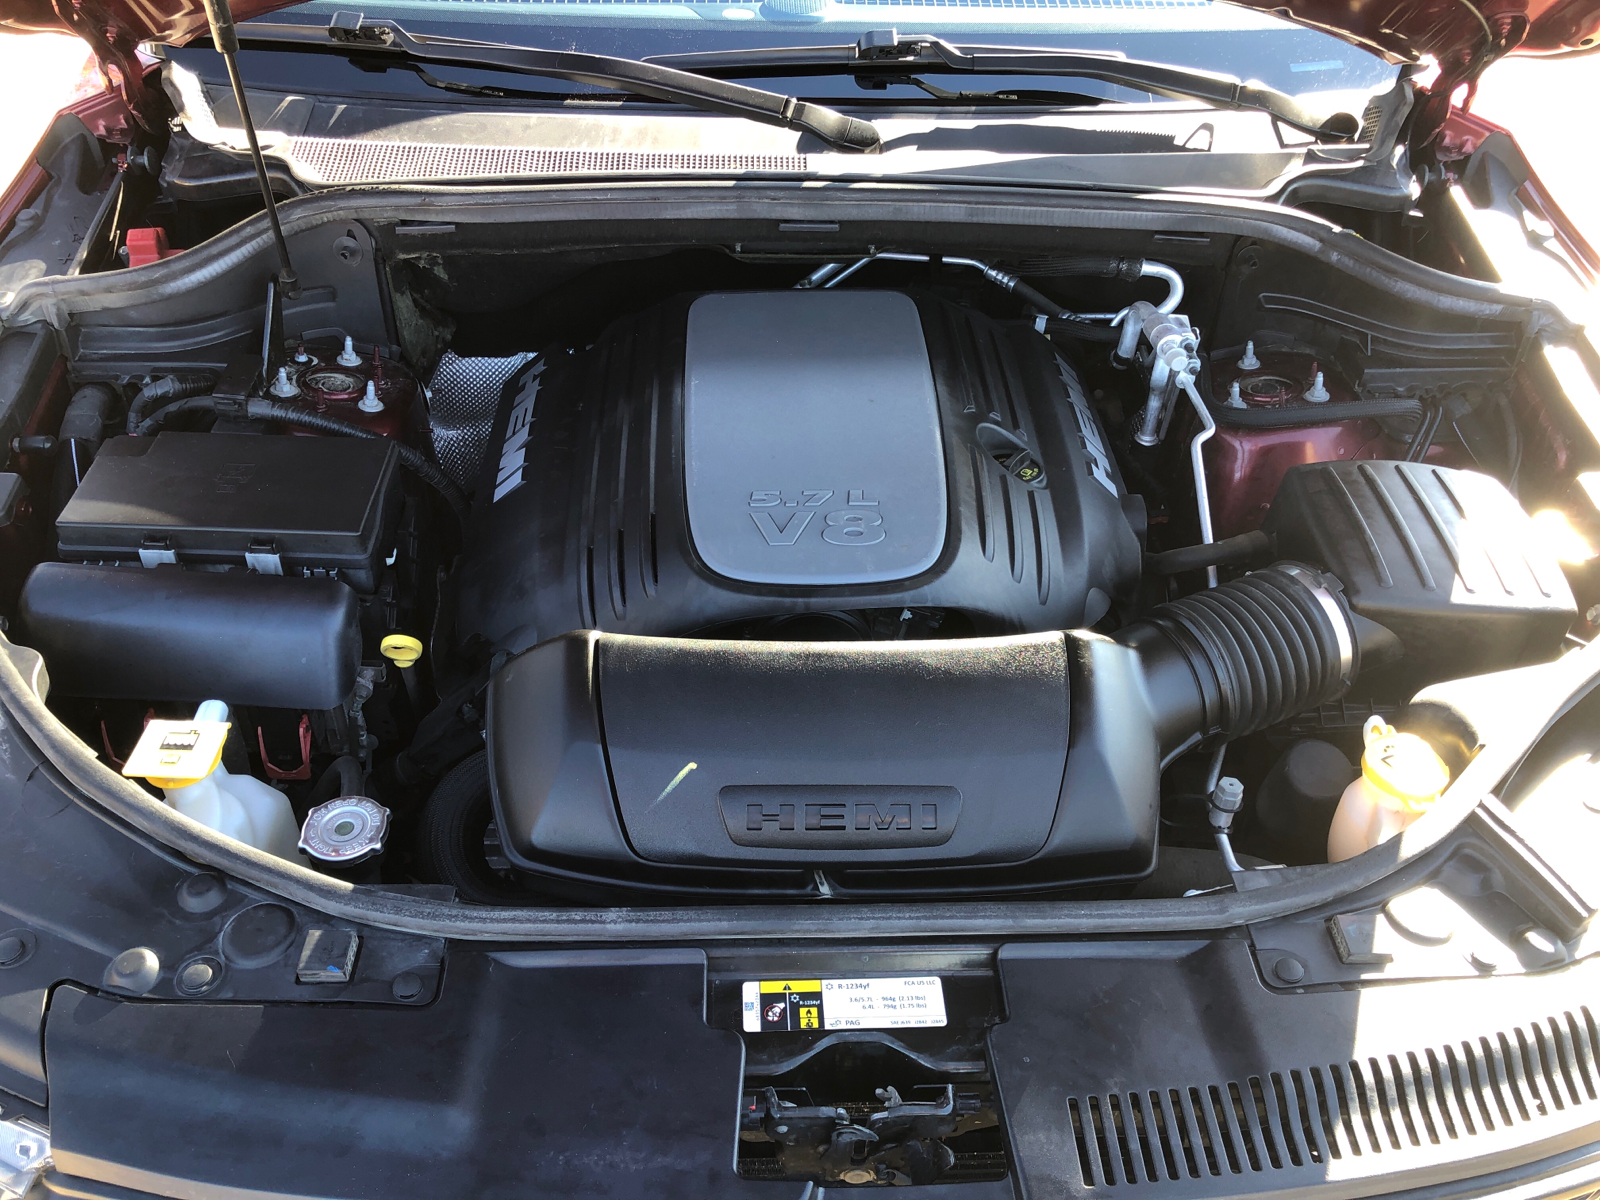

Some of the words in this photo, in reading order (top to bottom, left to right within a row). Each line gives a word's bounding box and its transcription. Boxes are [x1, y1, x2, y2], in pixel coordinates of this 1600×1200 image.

[493, 357, 546, 503] HEMI
[1054, 352, 1118, 499] HEMI
[749, 509, 887, 546] V8
[746, 803, 937, 830] HEMI
